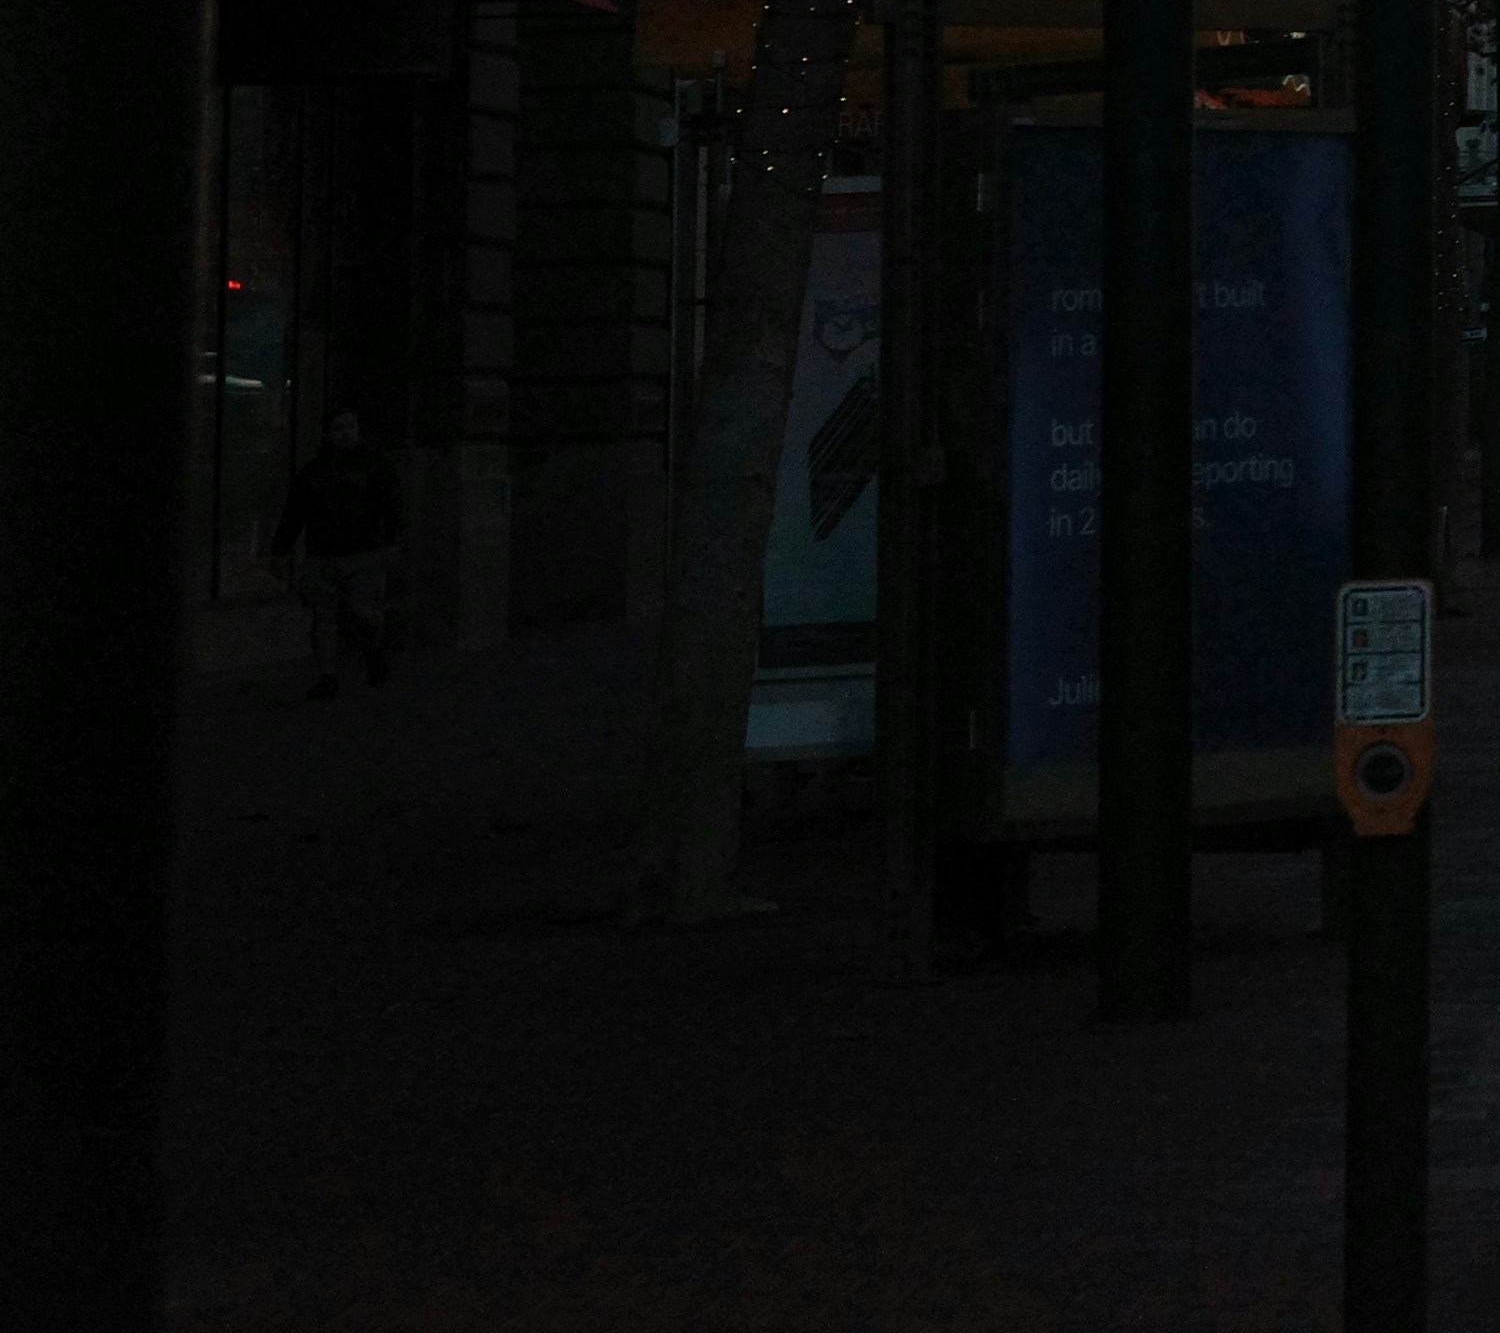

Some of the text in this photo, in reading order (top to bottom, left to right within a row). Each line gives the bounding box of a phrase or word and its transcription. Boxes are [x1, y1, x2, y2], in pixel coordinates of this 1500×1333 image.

[1213, 279, 1266, 309] built
[1050, 331, 1098, 359] in a
[1050, 418, 1095, 447] but
[1222, 412, 1258, 440] do
[1192, 453, 1296, 489] eporting
[1048, 508, 1074, 539] in
